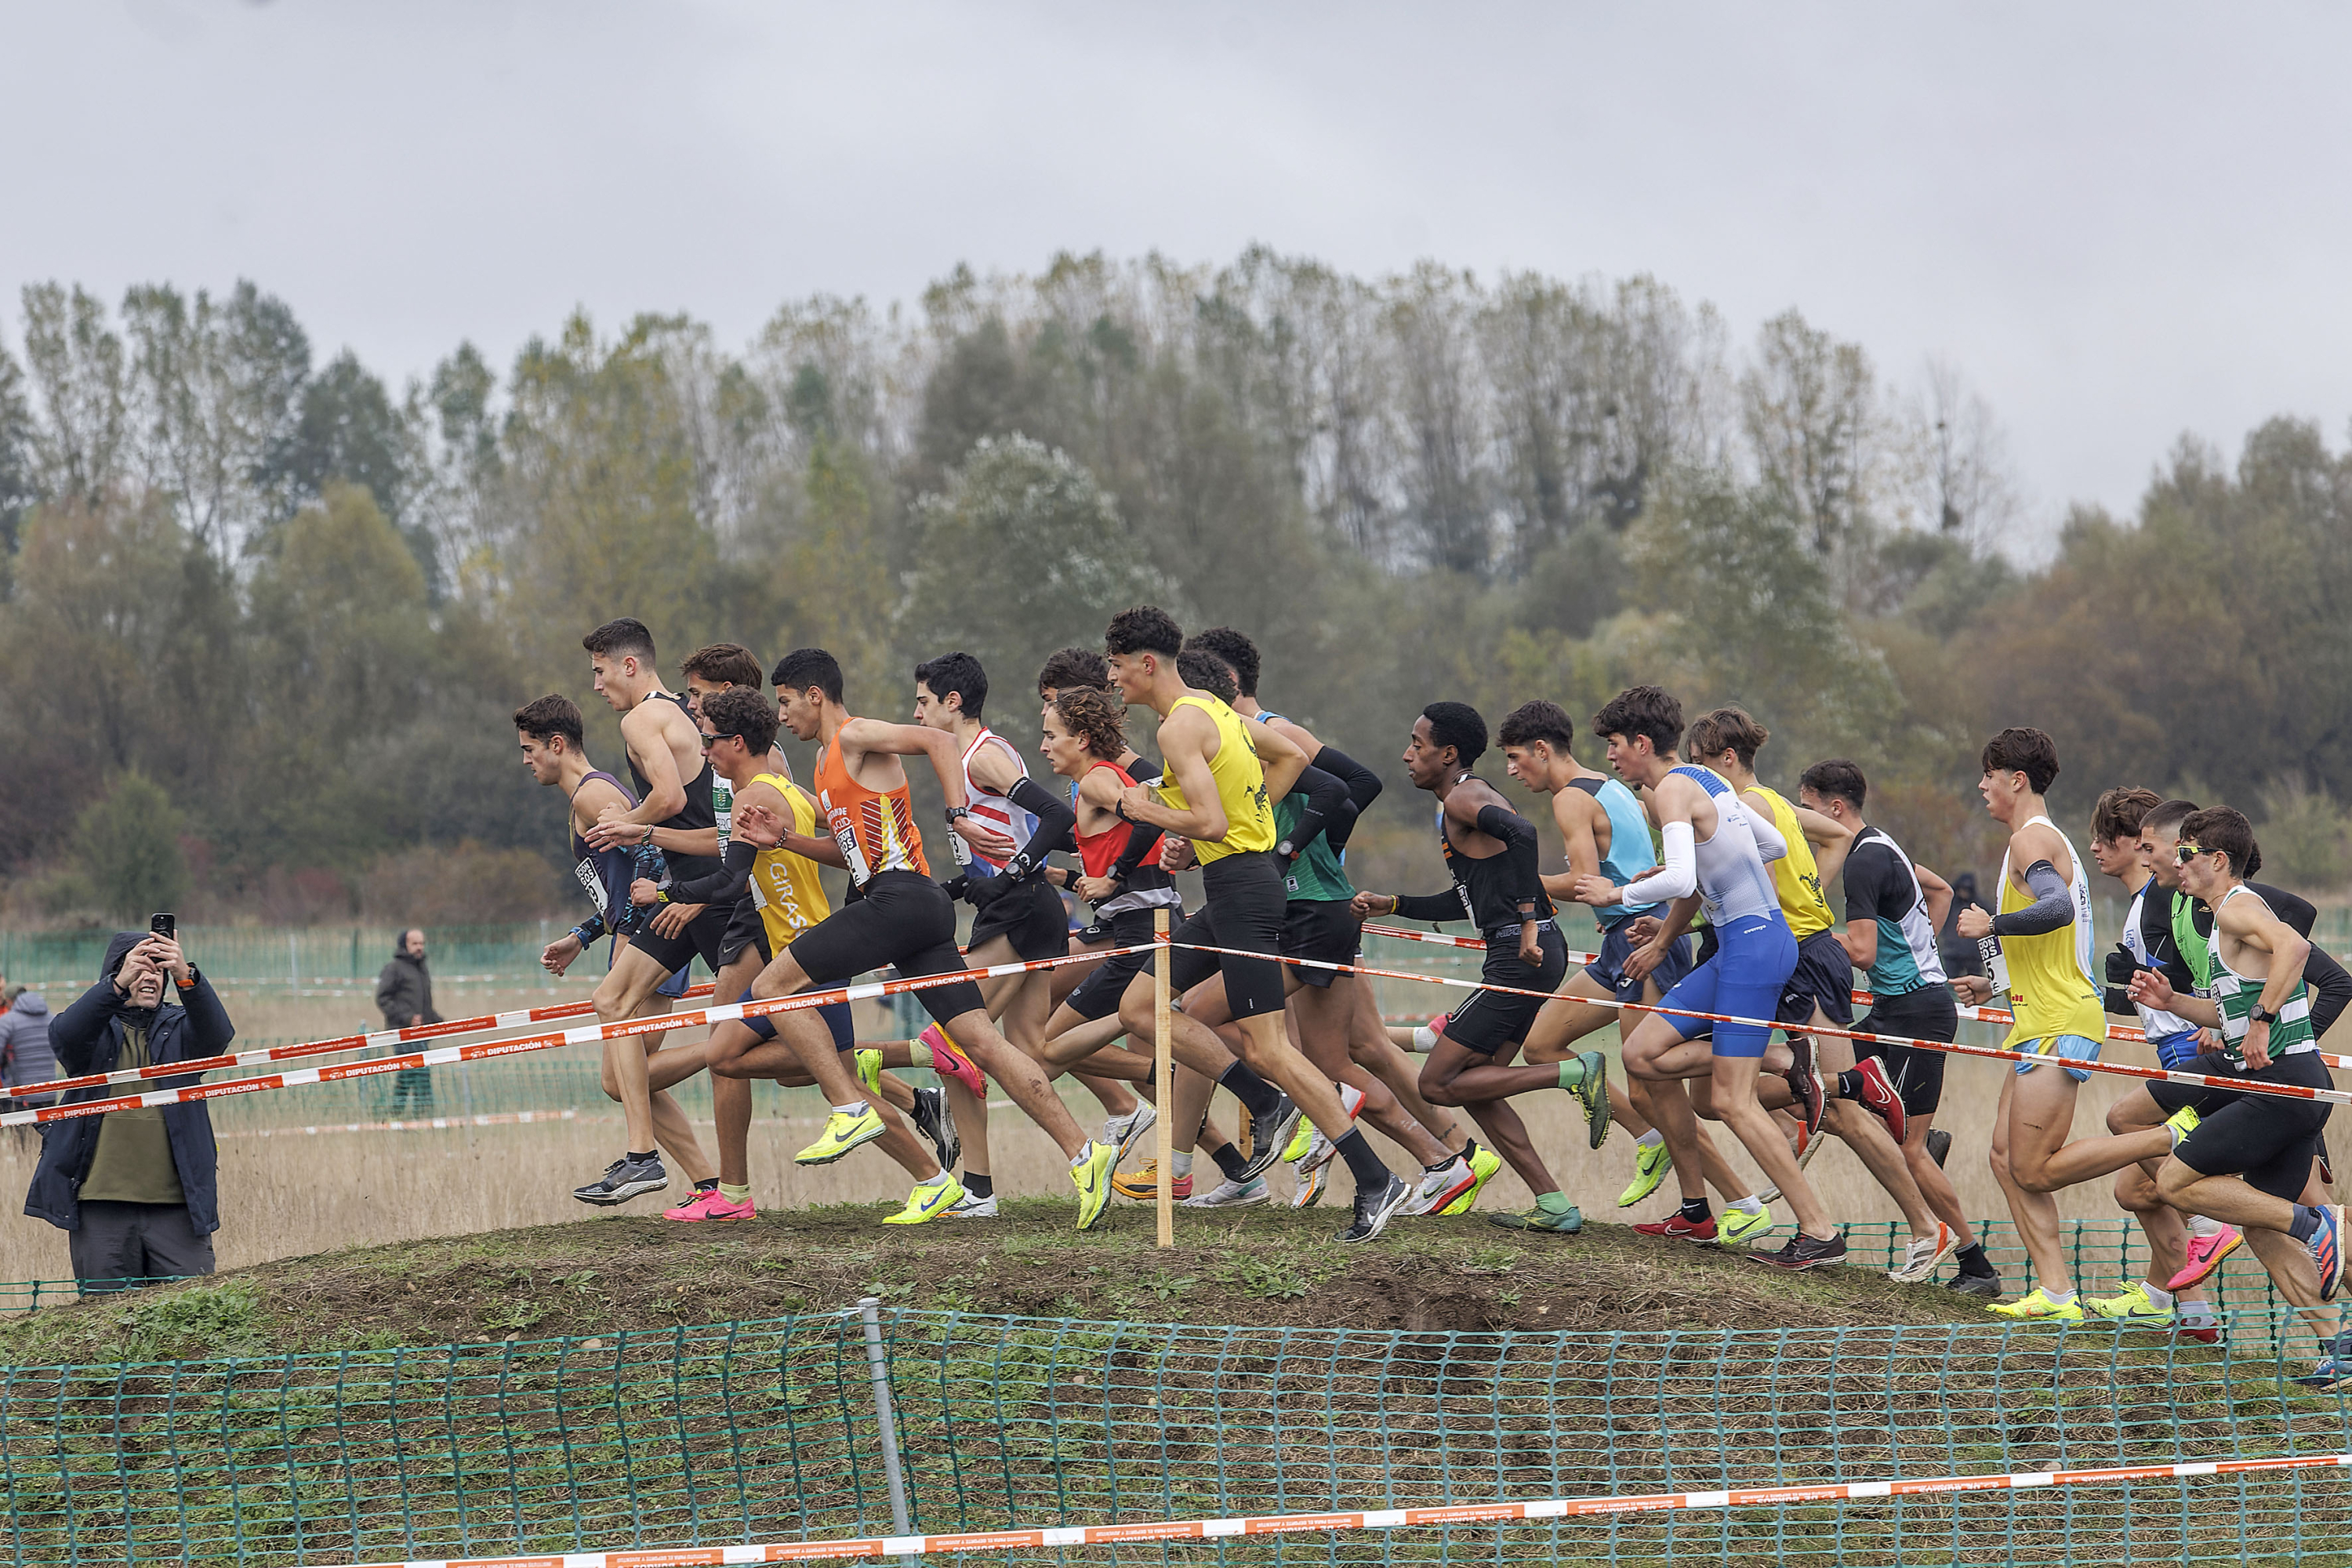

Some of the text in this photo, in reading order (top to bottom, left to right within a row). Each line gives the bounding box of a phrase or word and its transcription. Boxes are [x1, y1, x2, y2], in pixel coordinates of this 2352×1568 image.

[910, 975, 965, 990] DIPUTACIÓN
[769, 997, 824, 1013] DIPUTACIÓN
[627, 1019, 682, 1034] DIPUTACIÓN
[487, 1041, 542, 1055] DIPUTACIÓN
[346, 1062, 400, 1076] DIPUTACIÓN
[205, 1083, 260, 1097] DIPUTACIÓN
[64, 1104, 118, 1117] DIPUTACIÓN
